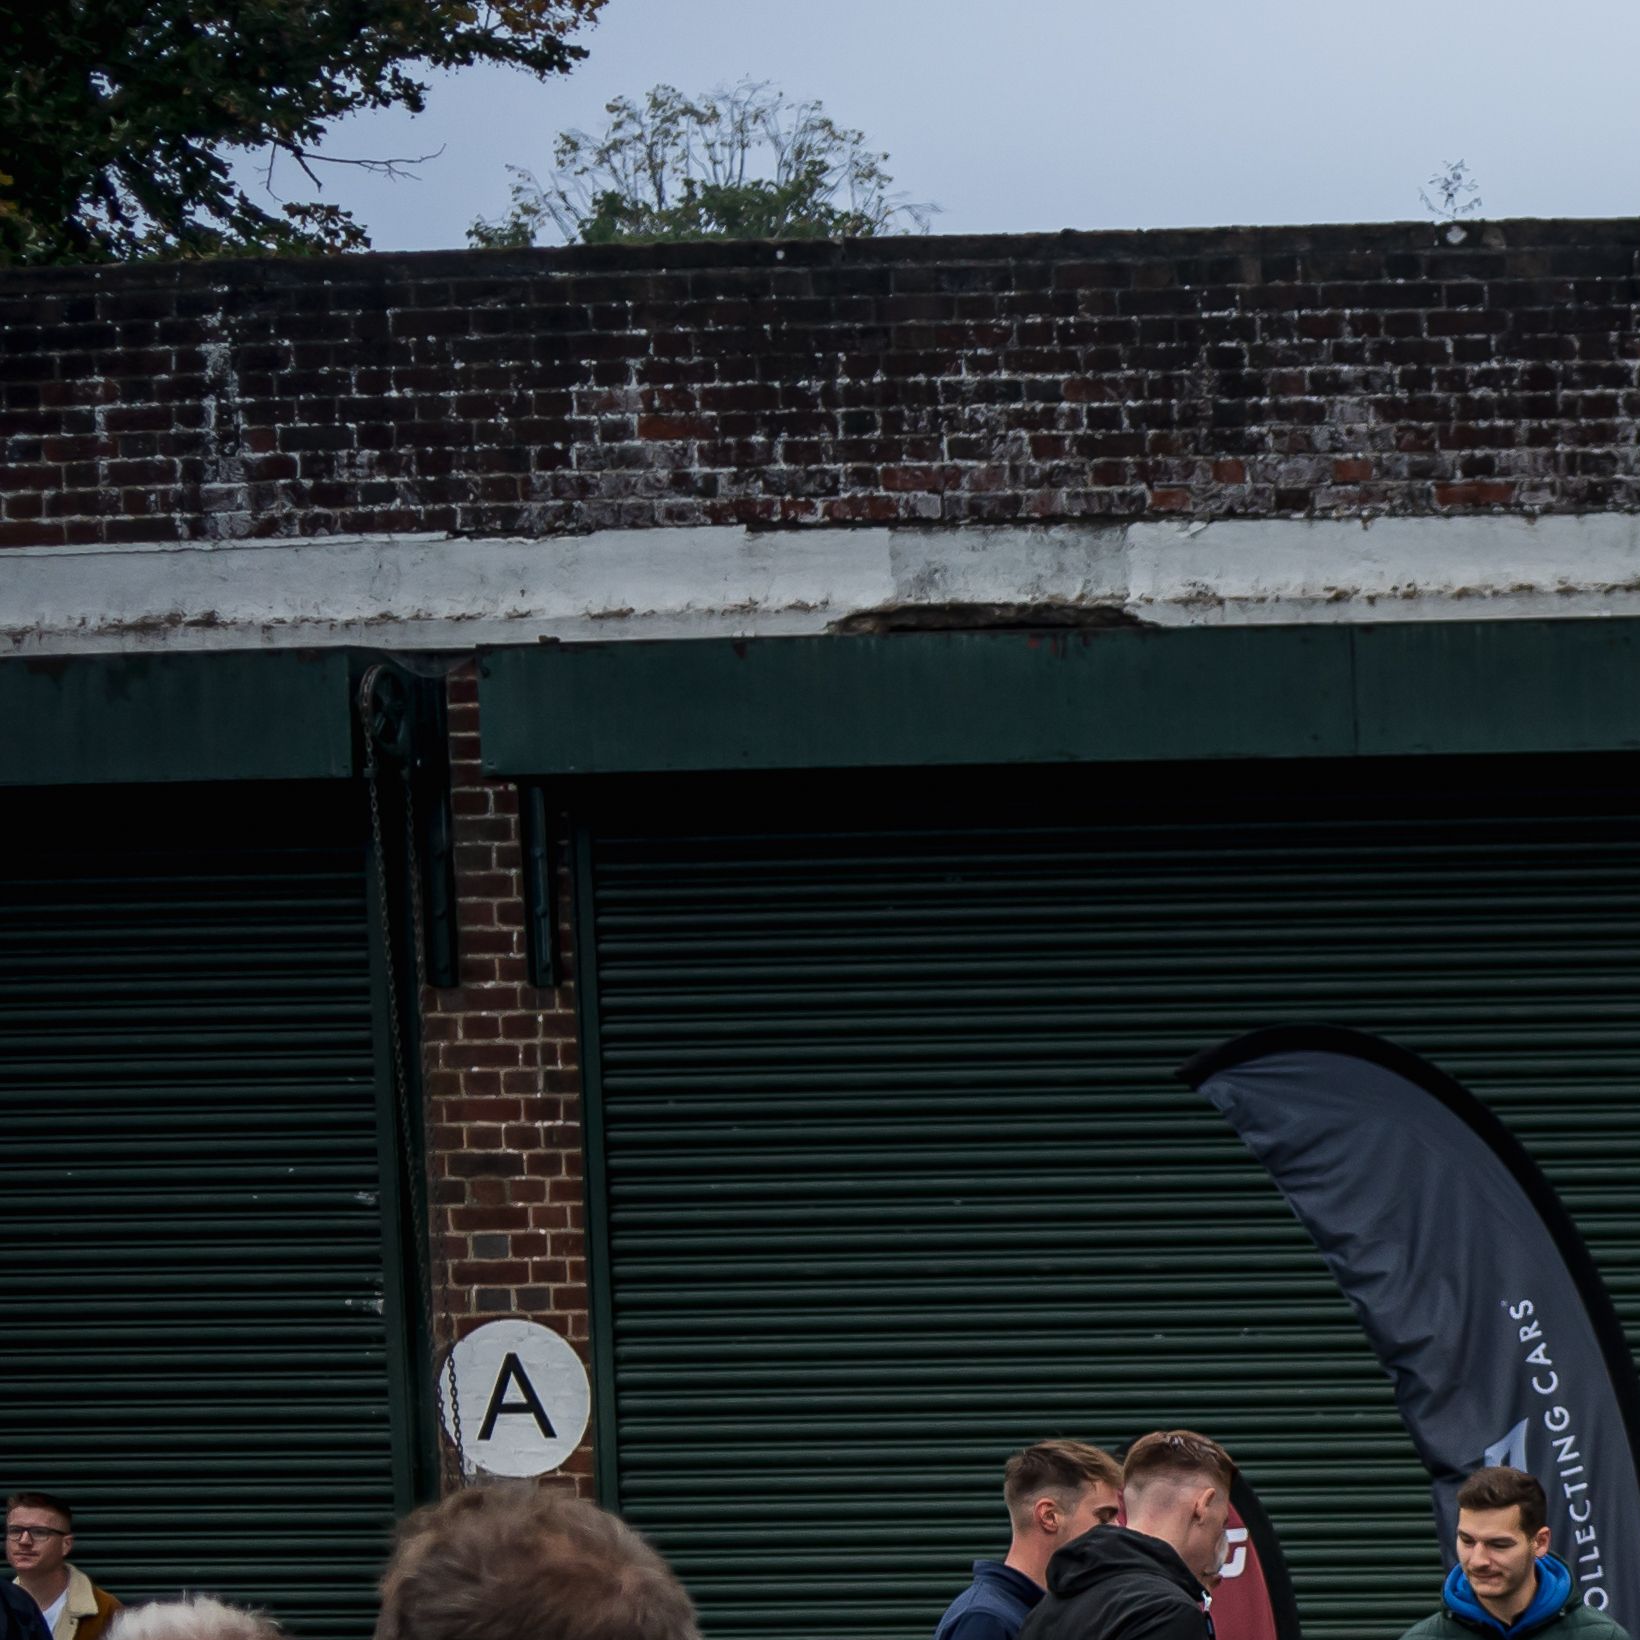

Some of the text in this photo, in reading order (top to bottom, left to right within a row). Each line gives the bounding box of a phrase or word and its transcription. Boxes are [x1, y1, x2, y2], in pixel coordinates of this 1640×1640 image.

[477, 1352, 558, 1440] A
[1508, 1298, 1609, 1611] OLLECTING CARS
